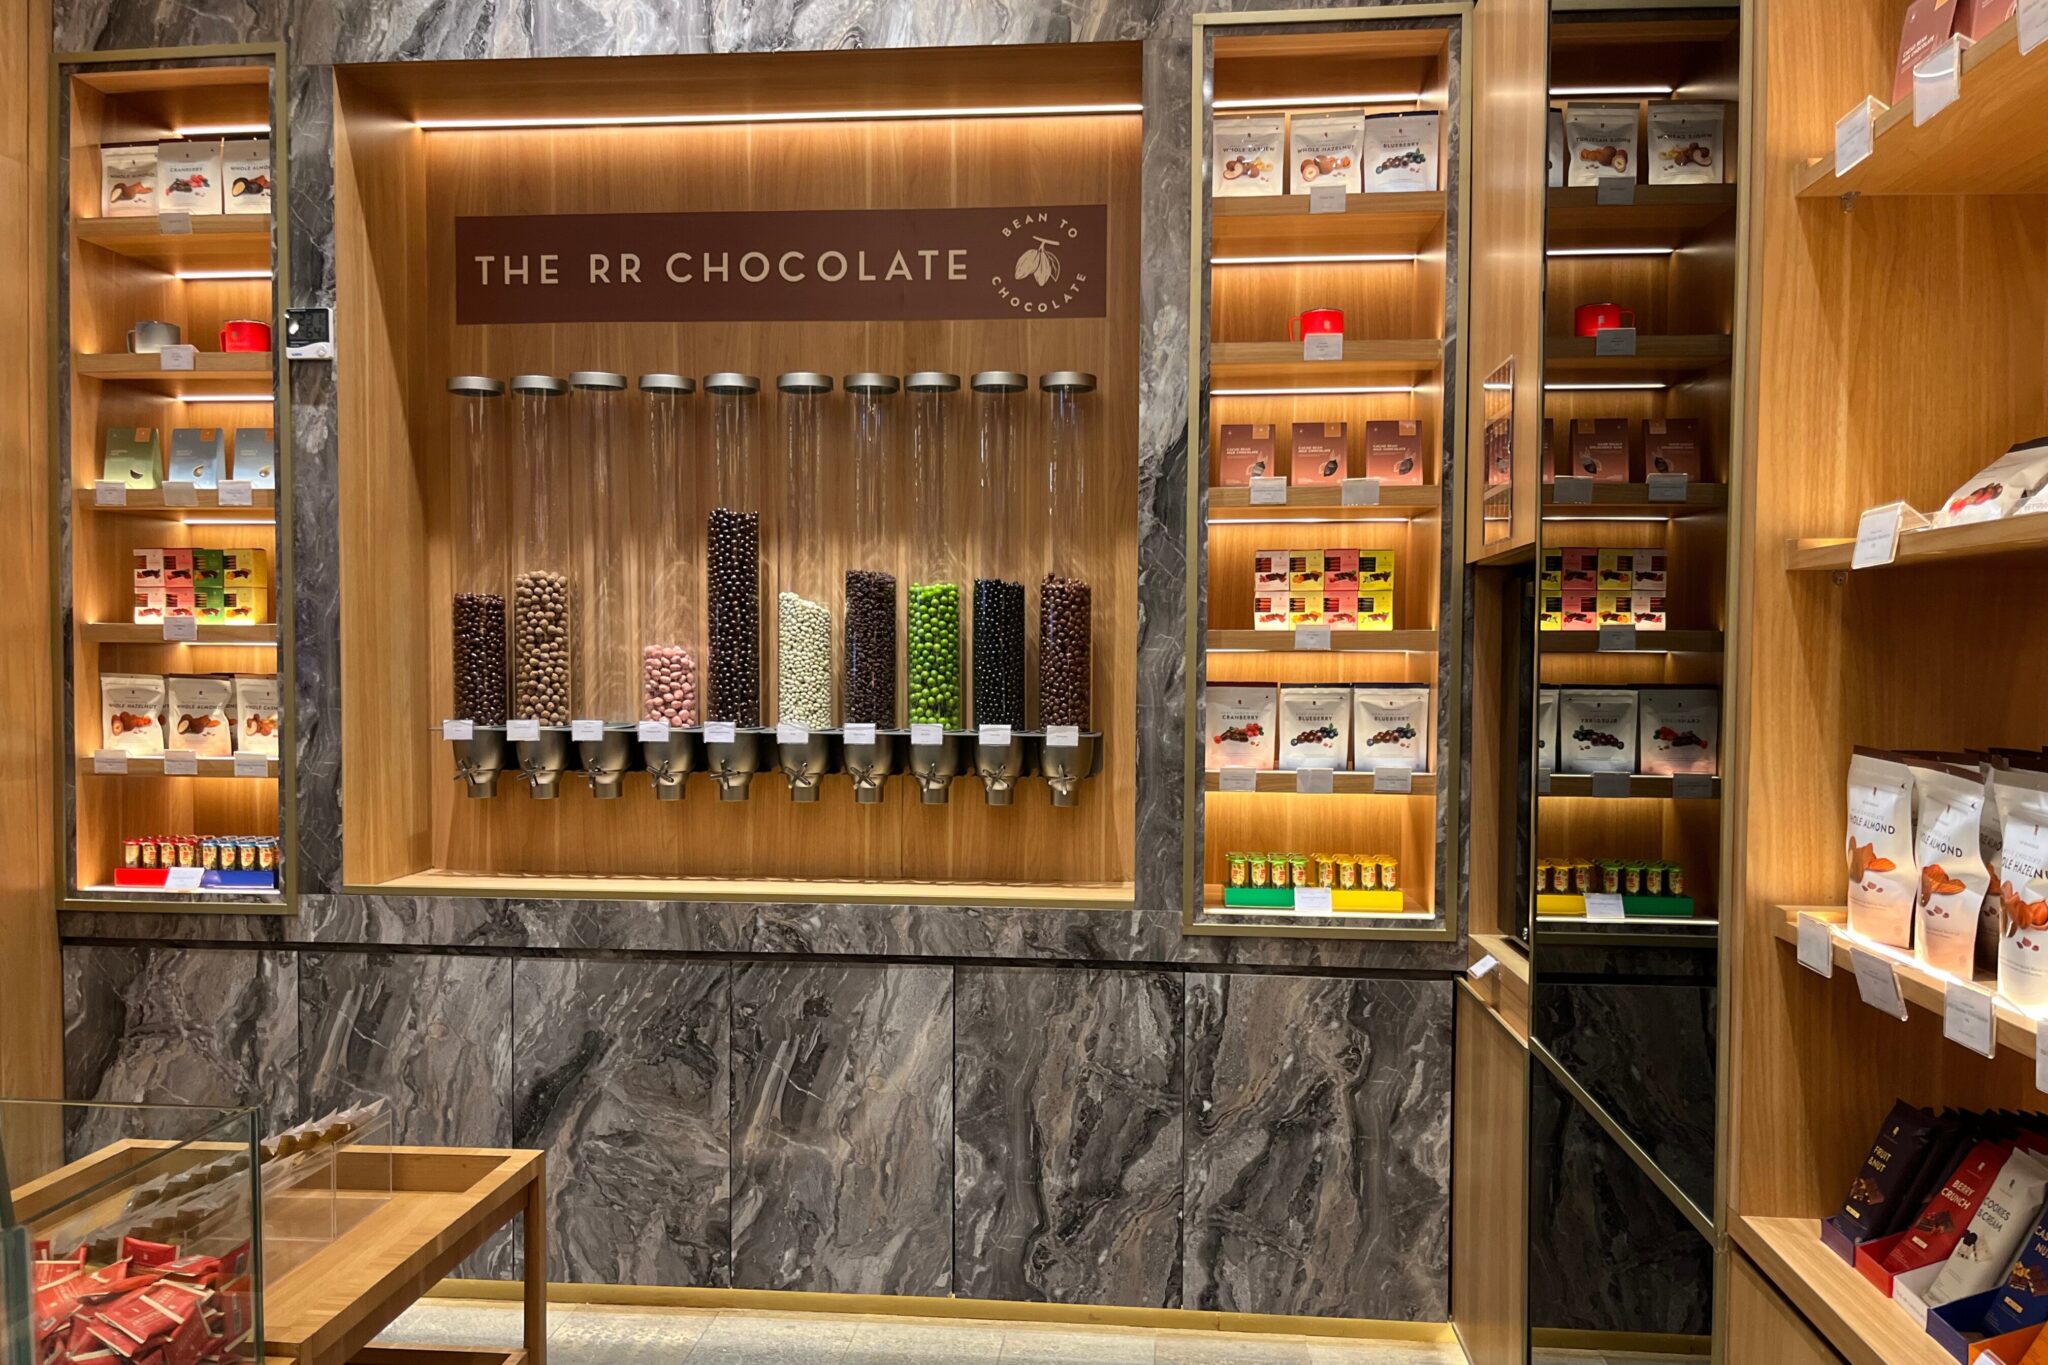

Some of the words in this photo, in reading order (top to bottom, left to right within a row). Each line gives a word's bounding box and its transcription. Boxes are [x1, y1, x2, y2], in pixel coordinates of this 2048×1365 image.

[1002, 212, 1048, 237] BEAN
[1058, 219, 1078, 238] TO
[475, 254, 559, 285] THE
[590, 253, 642, 284] RR
[666, 249, 968, 283] CHOCOLATE
[992, 272, 1086, 312] CHOCOLATE
[1863, 820, 1895, 834] ALMOND
[1930, 838, 1963, 858] ALMOND
[1941, 1187, 1972, 1210] CRUNCH
[1952, 1180, 1975, 1196] BERRY
[1984, 1197, 2010, 1220] COOKIES
